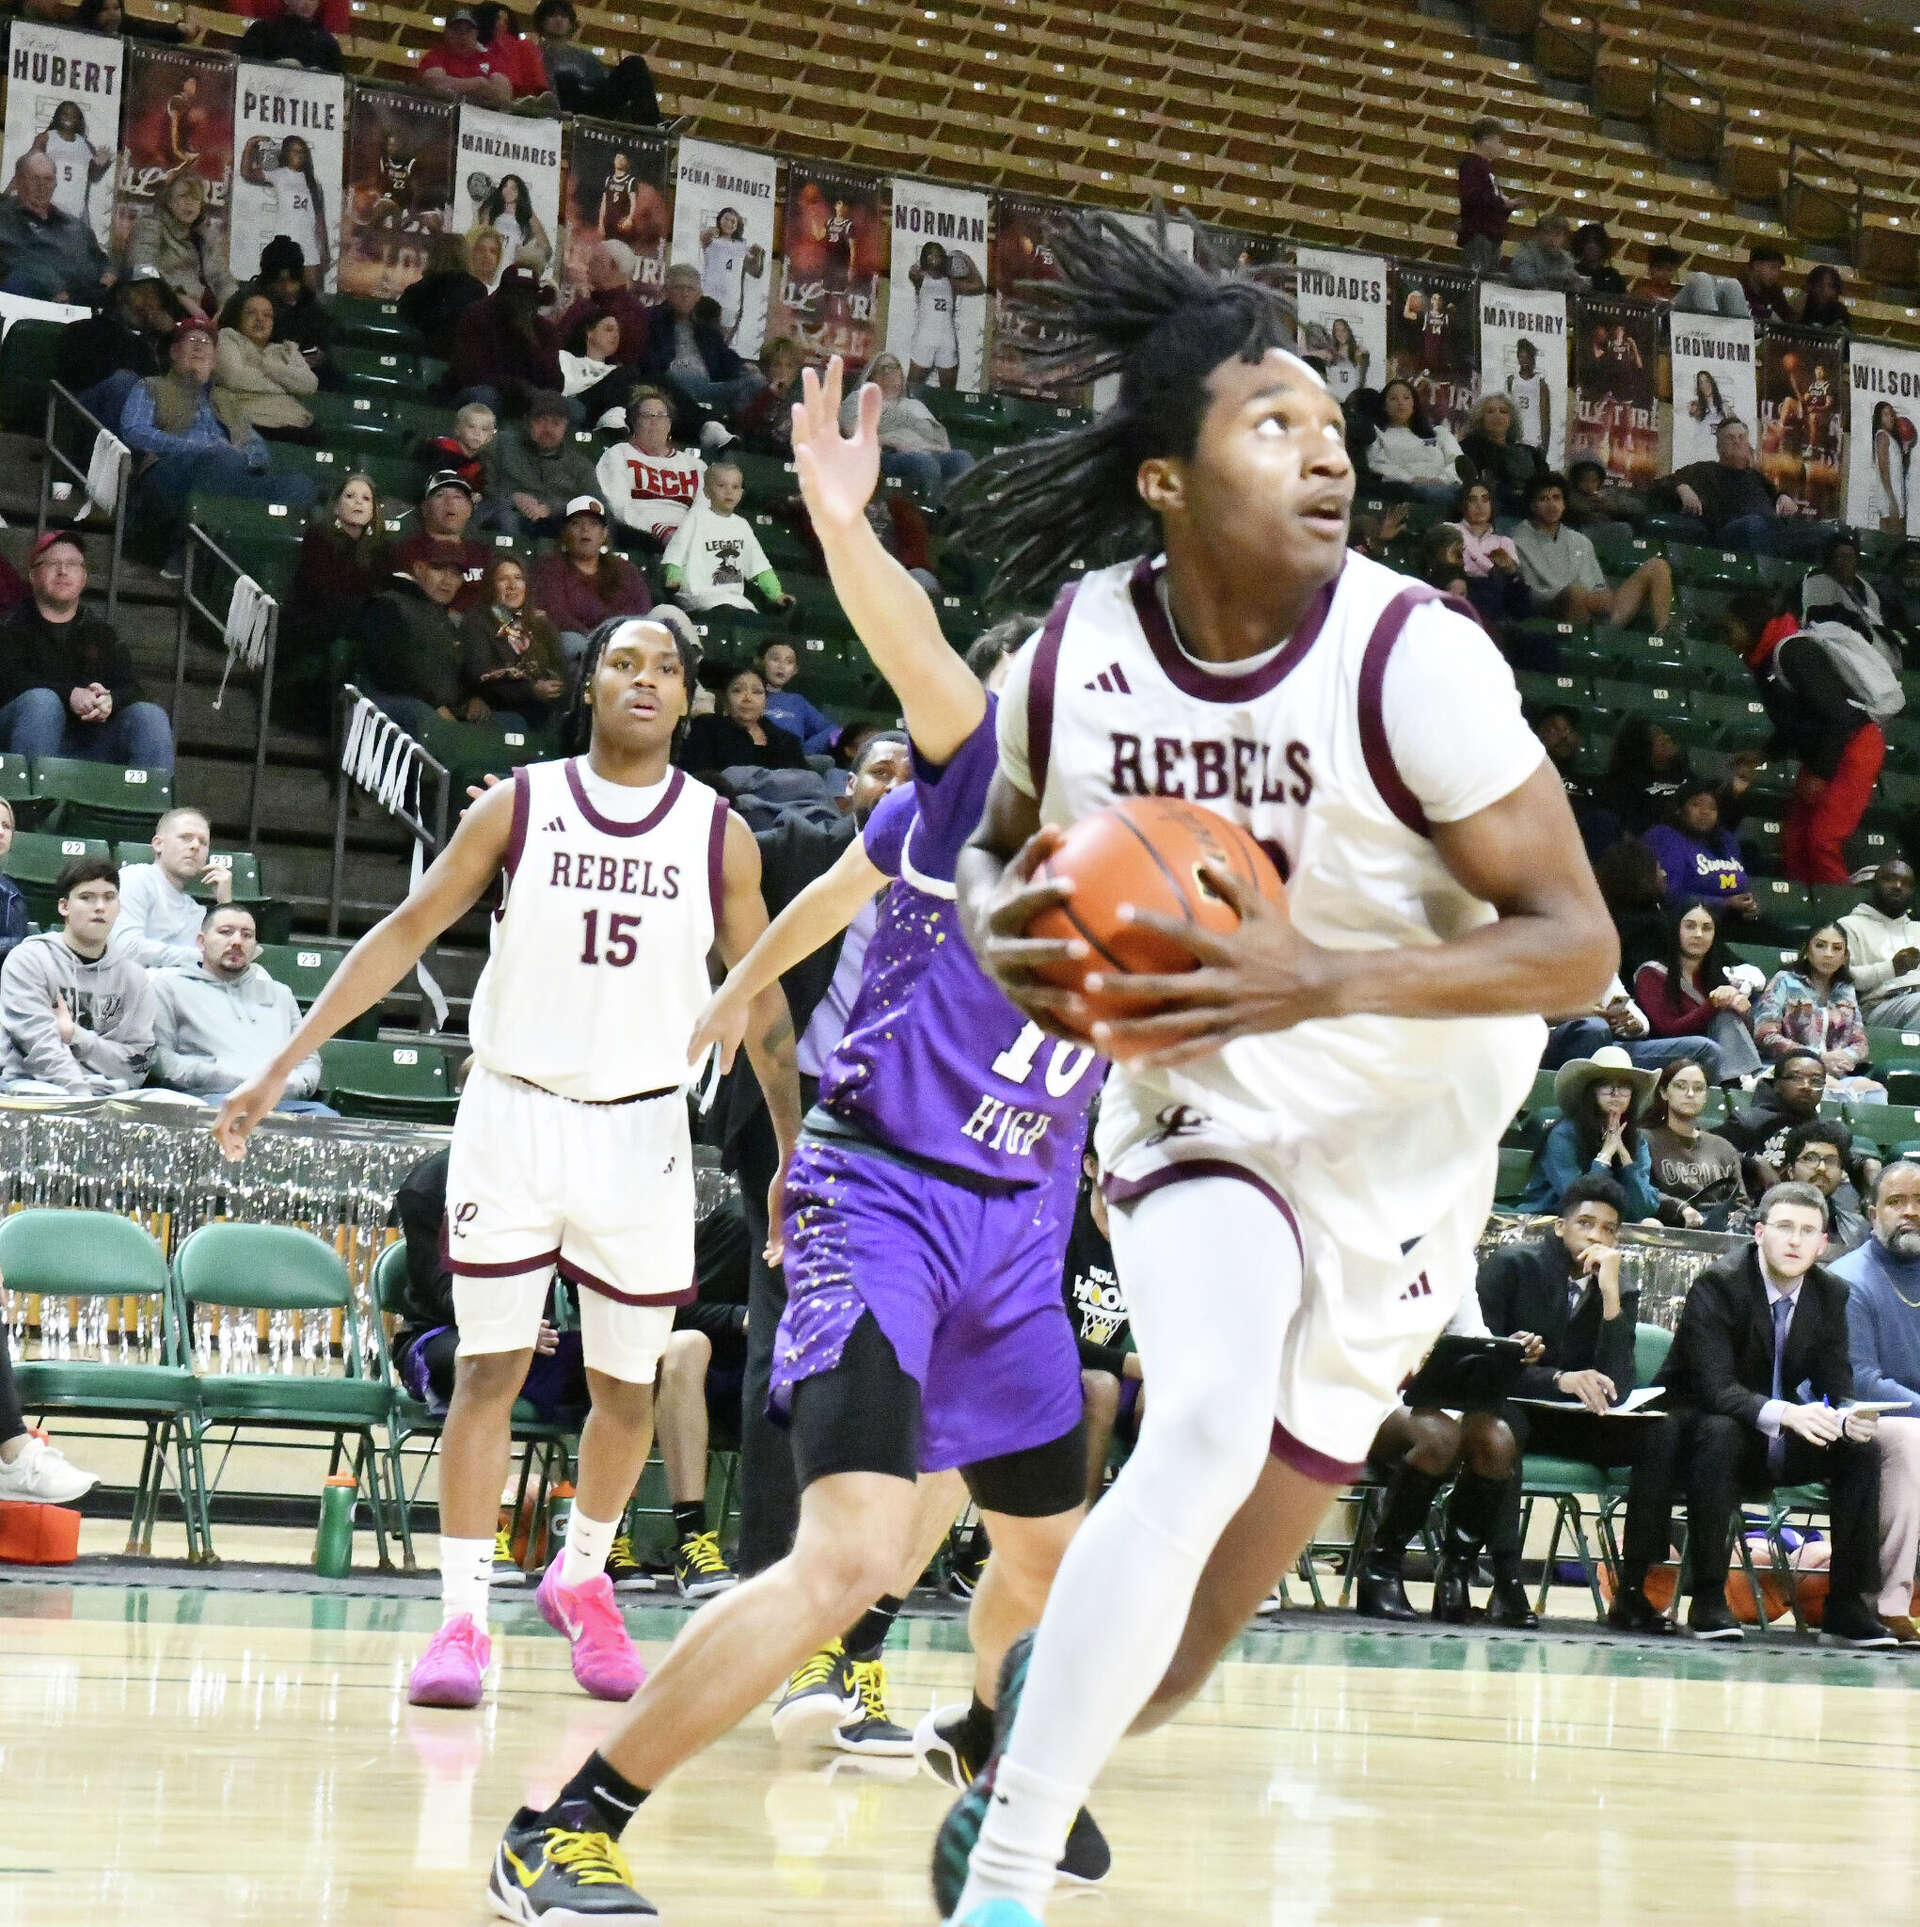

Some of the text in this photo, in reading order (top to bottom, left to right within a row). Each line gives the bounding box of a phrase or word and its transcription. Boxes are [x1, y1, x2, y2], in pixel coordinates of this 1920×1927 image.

[14, 49, 117, 96] HUBERT
[244, 90, 334, 131] PERTILE
[462, 133, 557, 167] MANZANARES
[64, 166, 73, 182] 5
[895, 204, 984, 243] NORMAN
[1484, 306, 1563, 334] MAYBERRY
[627, 460, 698, 500] TECH
[705, 540, 744, 551] LEGACY
[1110, 732, 1313, 806] REBELS
[550, 852, 680, 900] REBELS
[1719, 873, 1737, 889] M
[581, 909, 642, 967] 15
[992, 1020, 1096, 1098] 10
